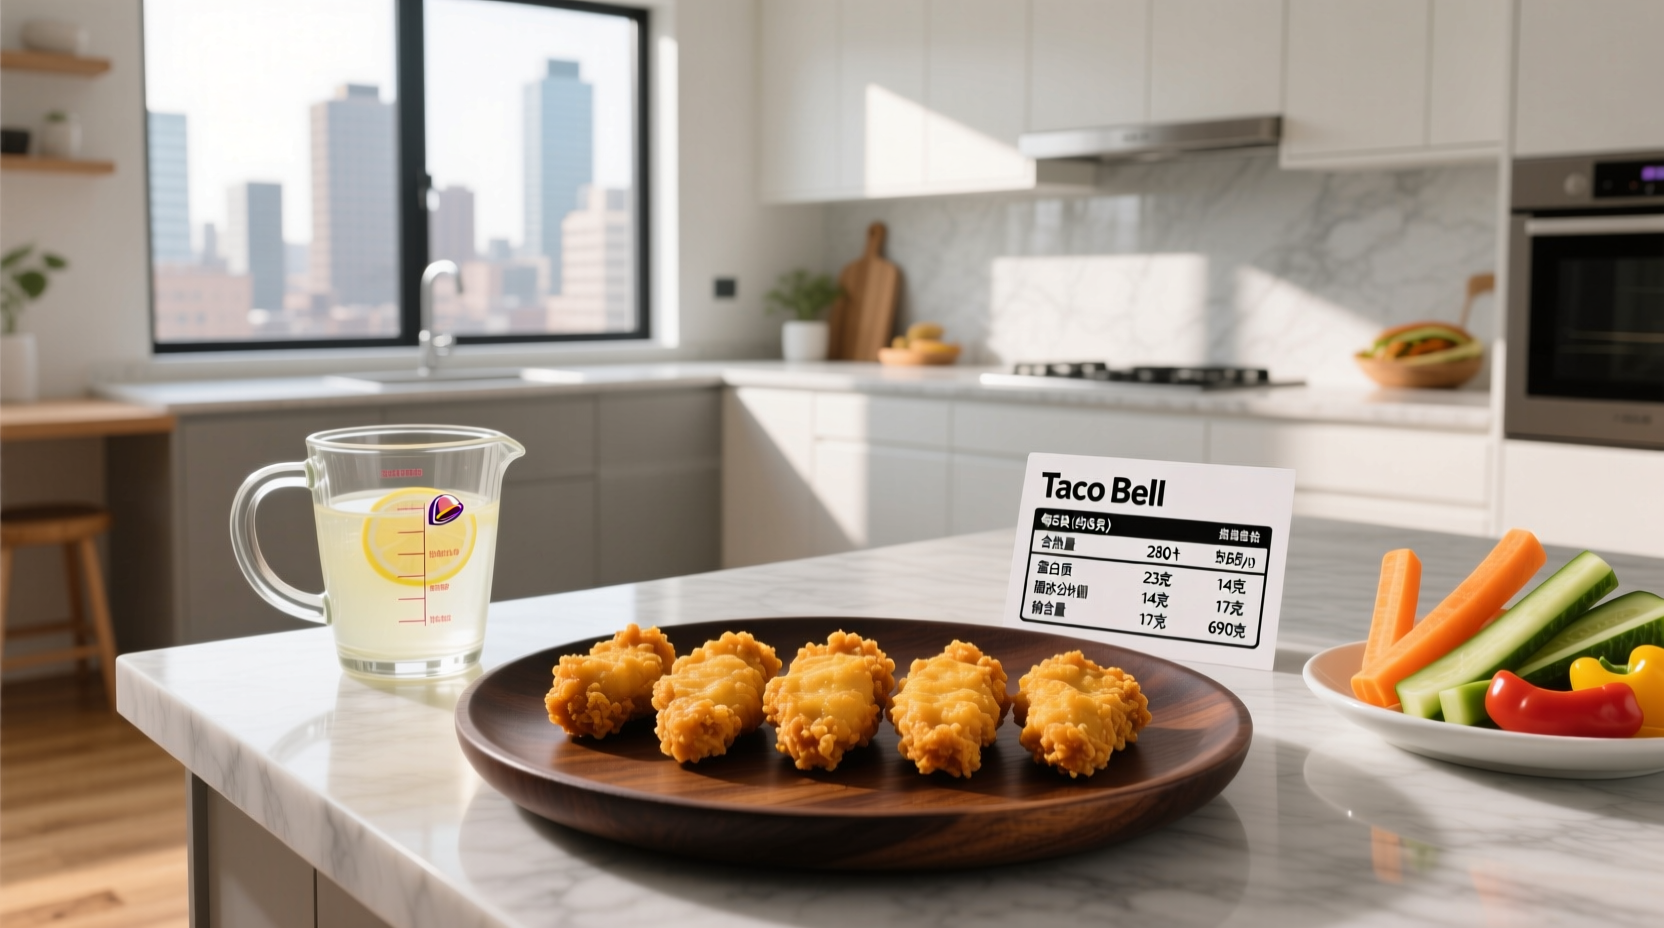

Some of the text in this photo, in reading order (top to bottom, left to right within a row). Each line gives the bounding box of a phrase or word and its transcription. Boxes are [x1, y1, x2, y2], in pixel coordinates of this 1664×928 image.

[1042, 471, 1166, 507] Taco Bell
[1143, 571, 1173, 587] 23克
[1217, 578, 1246, 595] 14克
[1141, 591, 1244, 616] 14克 17克
[1139, 612, 1246, 639] 17克 690克
